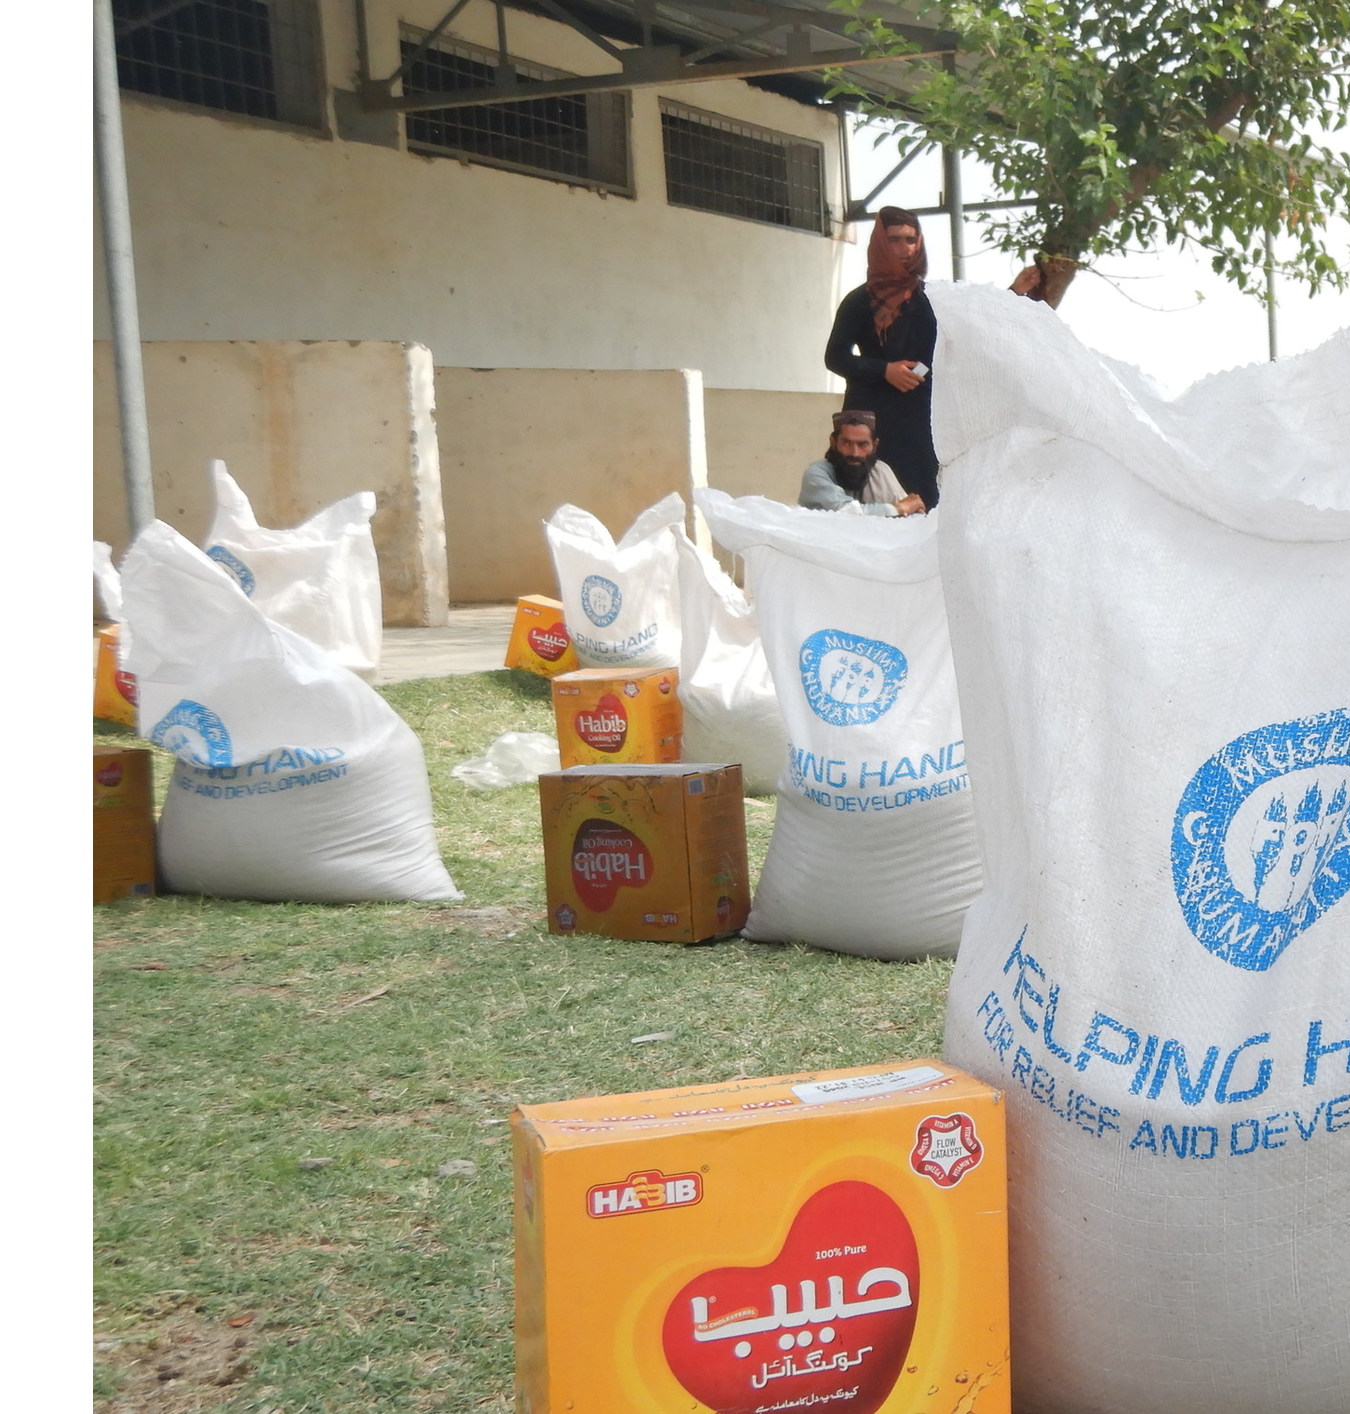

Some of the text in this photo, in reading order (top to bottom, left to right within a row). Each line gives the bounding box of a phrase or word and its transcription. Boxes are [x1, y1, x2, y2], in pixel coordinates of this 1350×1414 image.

[825, 634, 898, 672] MUSLIMS
[578, 713, 627, 734] Habib
[224, 763, 349, 800] DEVELOPMENT
[836, 773, 968, 812] DEVELOPMENT
[574, 851, 646, 881] Habib
[931, 1147, 962, 1160] CATALYST
[936, 1137, 957, 1149] FLOW
[1129, 1119, 1219, 1160] AND
[593, 1178, 698, 1214] HABIB
[815, 1244, 867, 1260] 100% Pure
